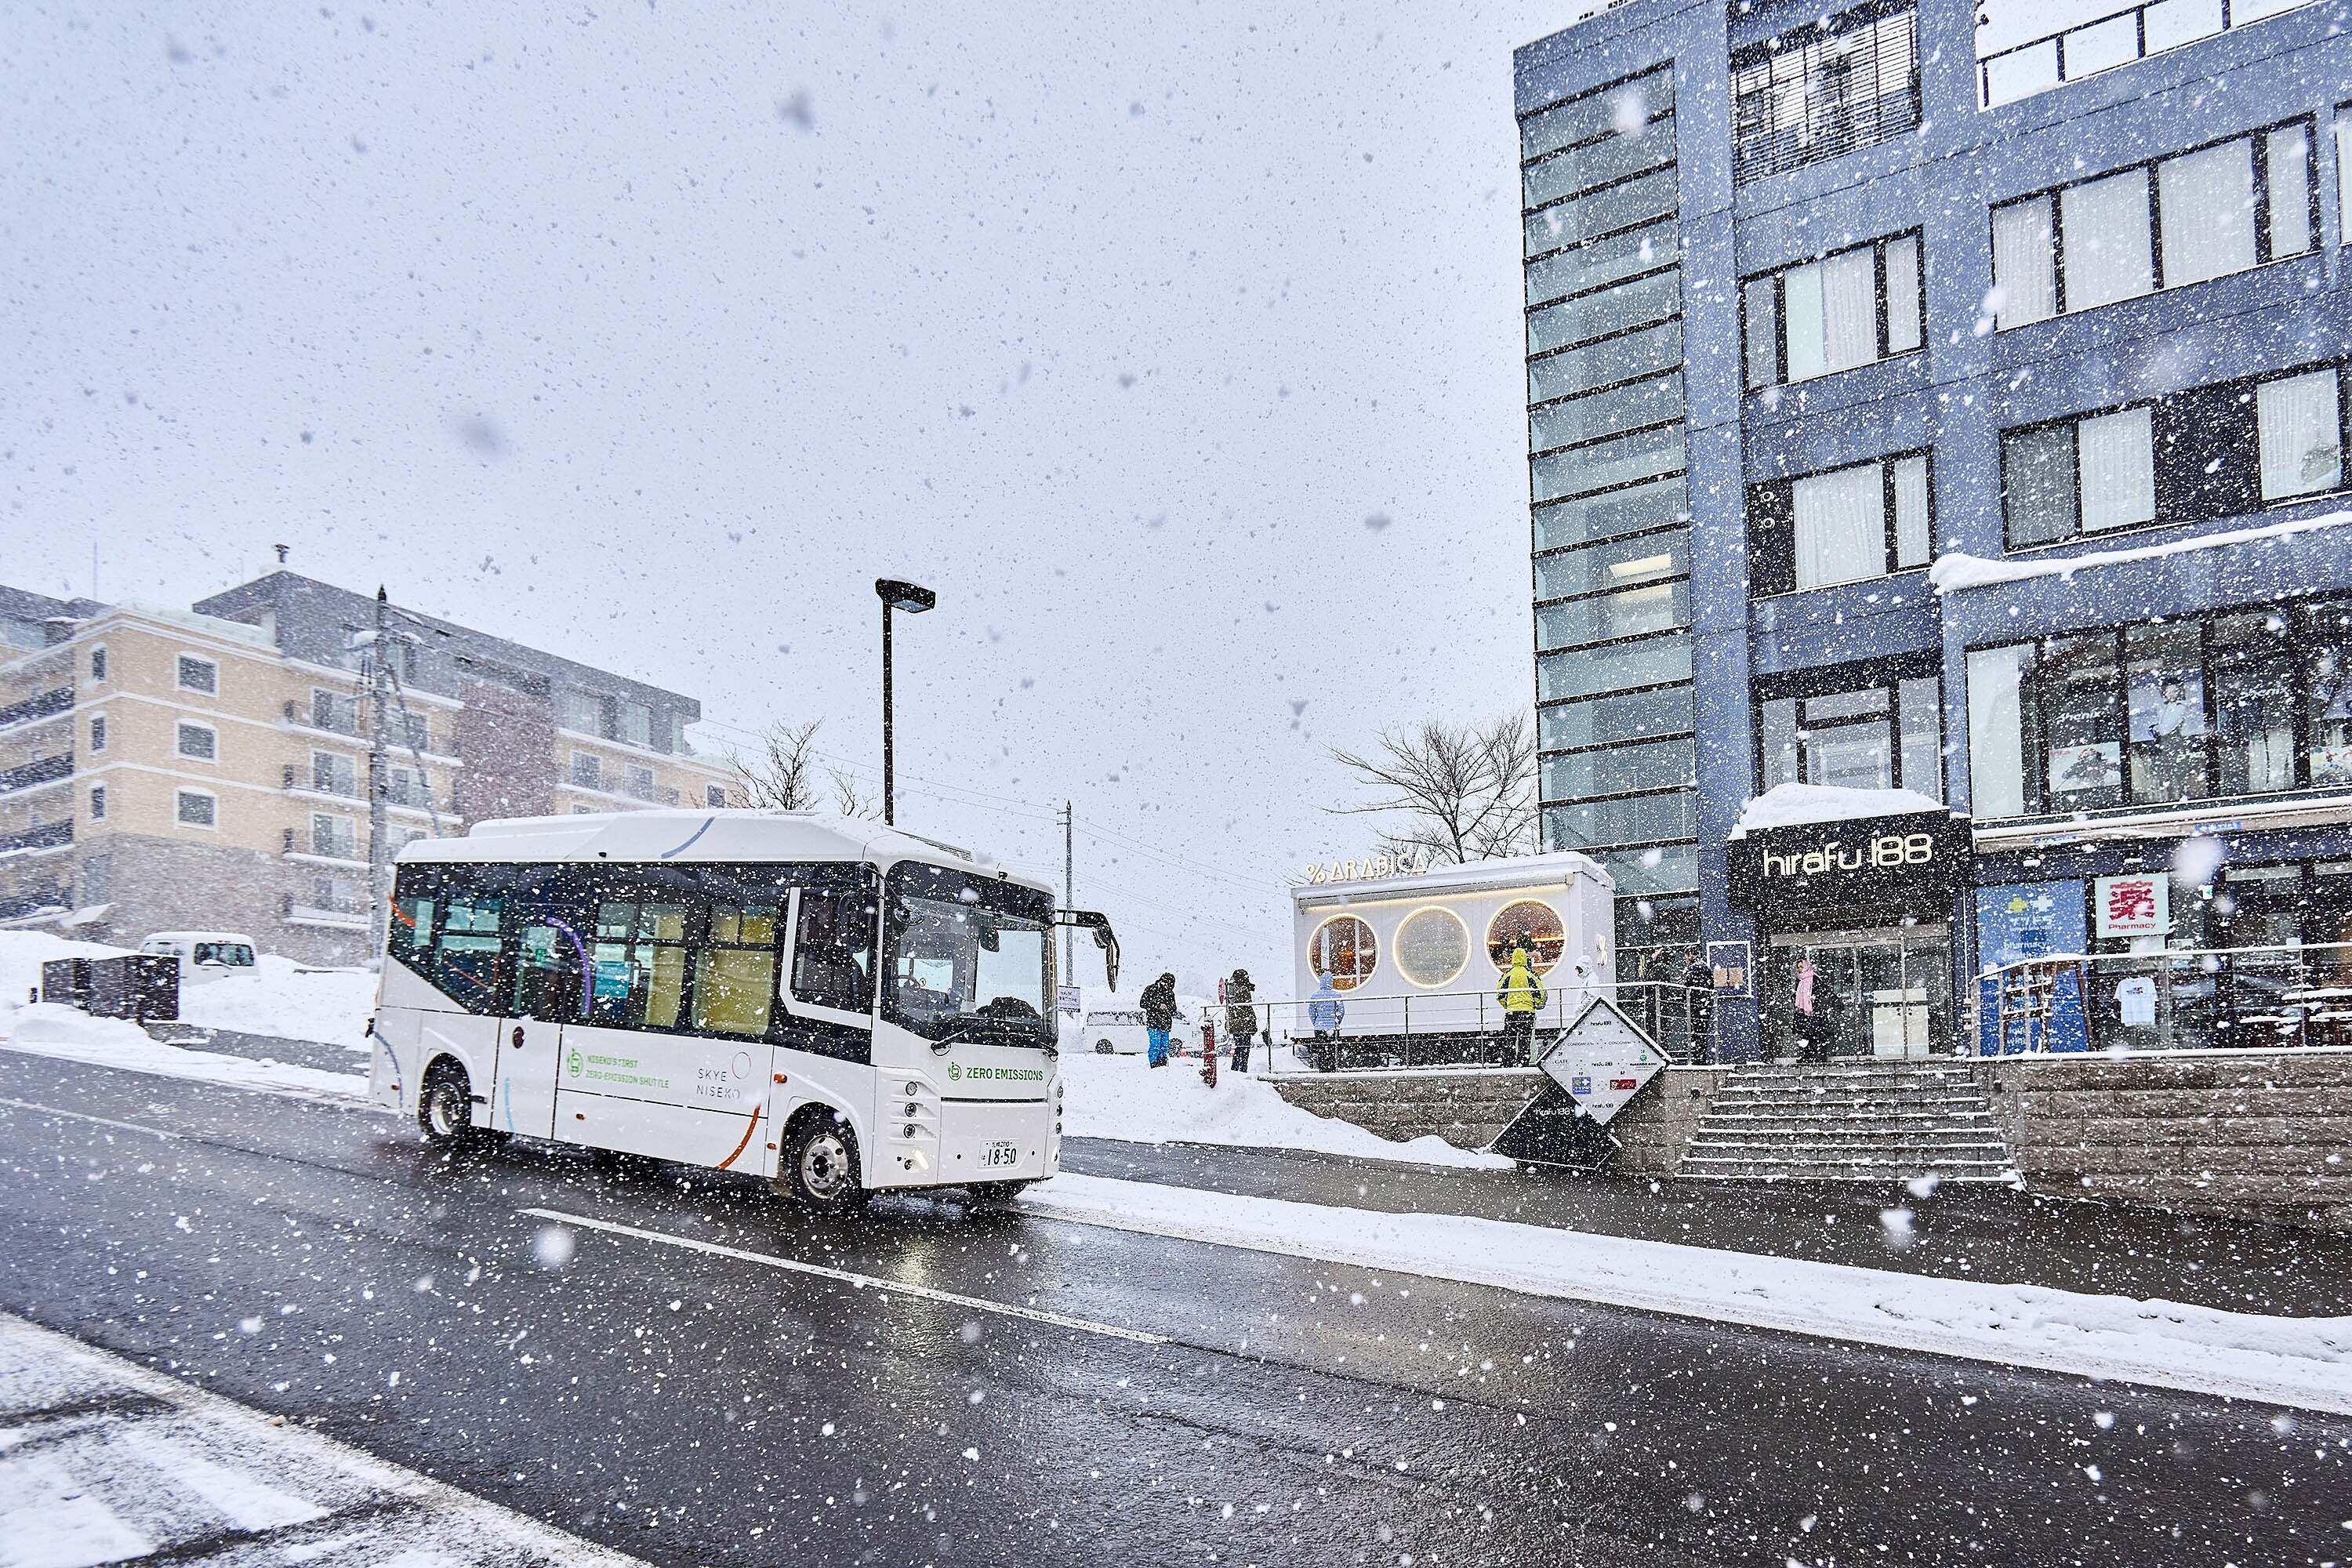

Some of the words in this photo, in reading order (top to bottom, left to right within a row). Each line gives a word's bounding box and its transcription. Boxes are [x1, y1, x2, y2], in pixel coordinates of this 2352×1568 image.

[1330, 851, 1427, 882] ARABICA
[2108, 880, 2154, 920] 薬
[2003, 942, 2047, 950] pharmacy
[698, 1069, 728, 1082] SKYE
[966, 1067, 993, 1080] ZERO
[995, 1069, 1044, 1081] EMISSIONS
[639, 1077, 669, 1088] SHUTTLE
[696, 1084, 741, 1098] NISEKO
